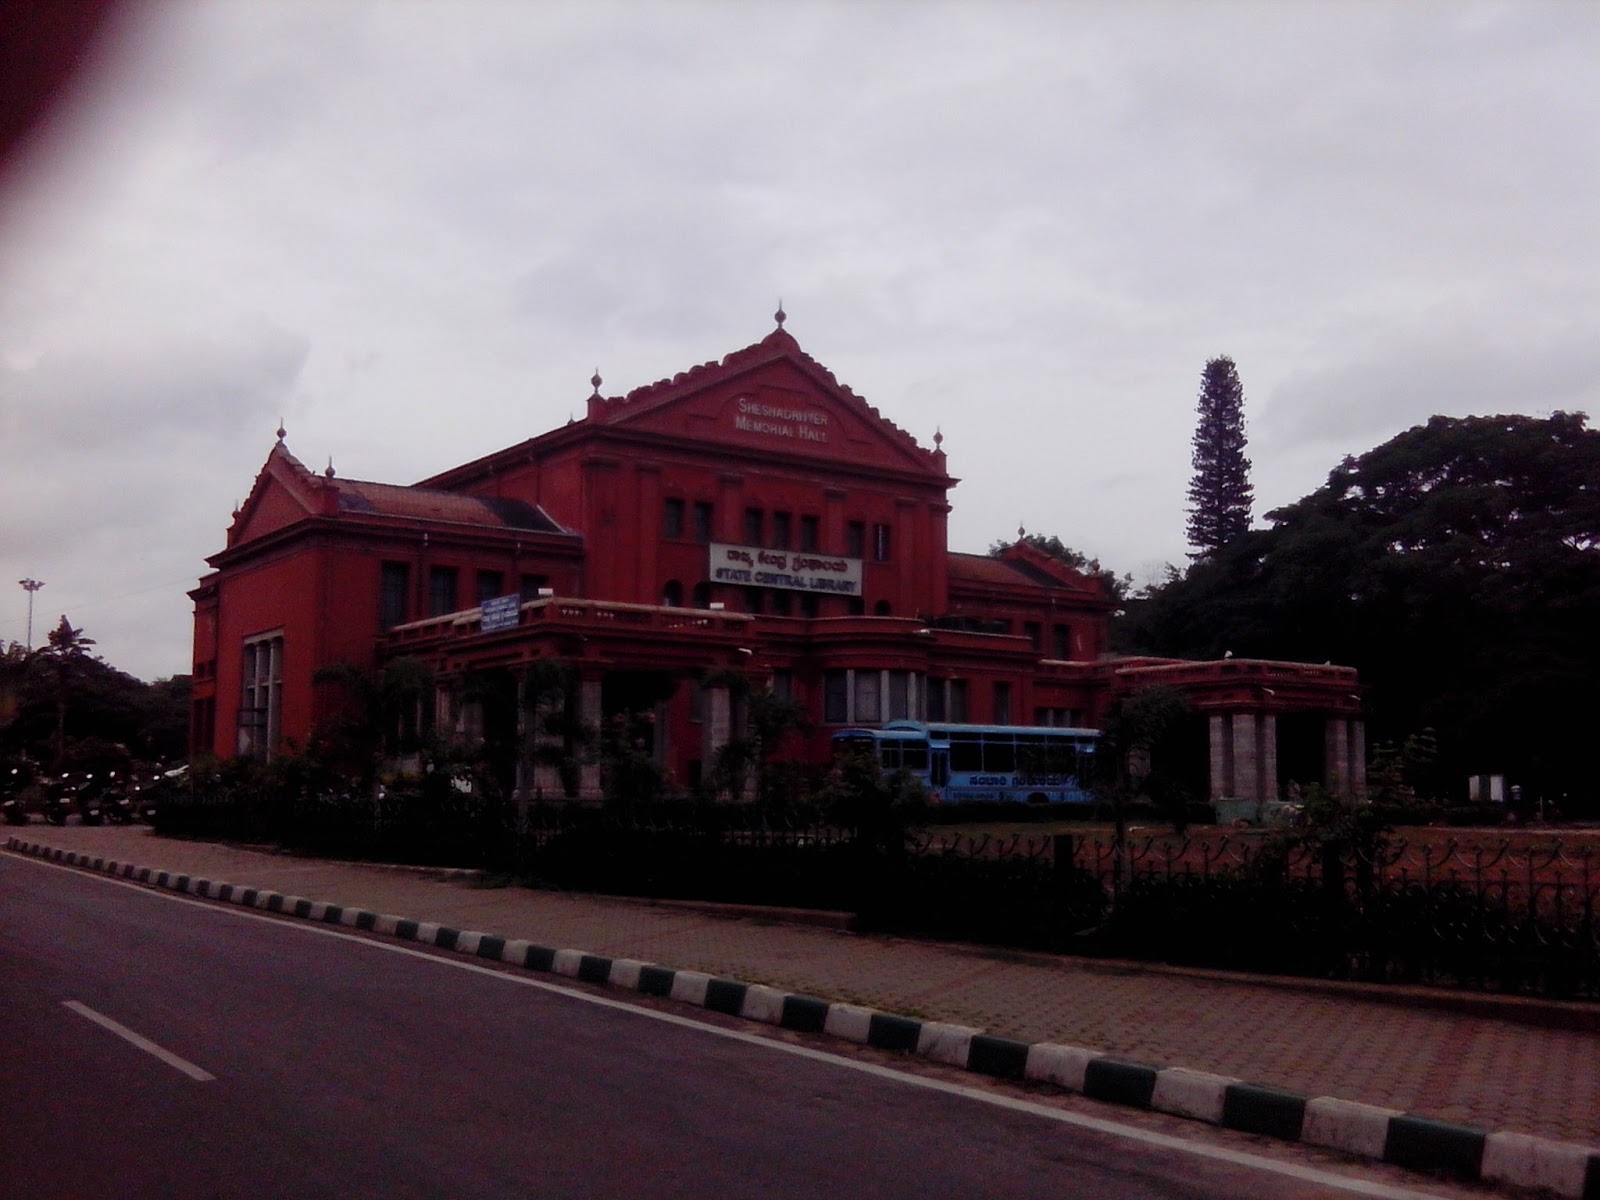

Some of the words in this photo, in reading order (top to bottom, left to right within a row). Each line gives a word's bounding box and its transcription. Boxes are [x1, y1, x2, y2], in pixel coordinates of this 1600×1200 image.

[735, 415, 793, 438] MEMORIAL
[799, 425, 828, 443] HALL
[715, 567, 752, 583] STATE
[754, 571, 807, 588] CENTRAL
[810, 577, 857, 593] LIBRARY
